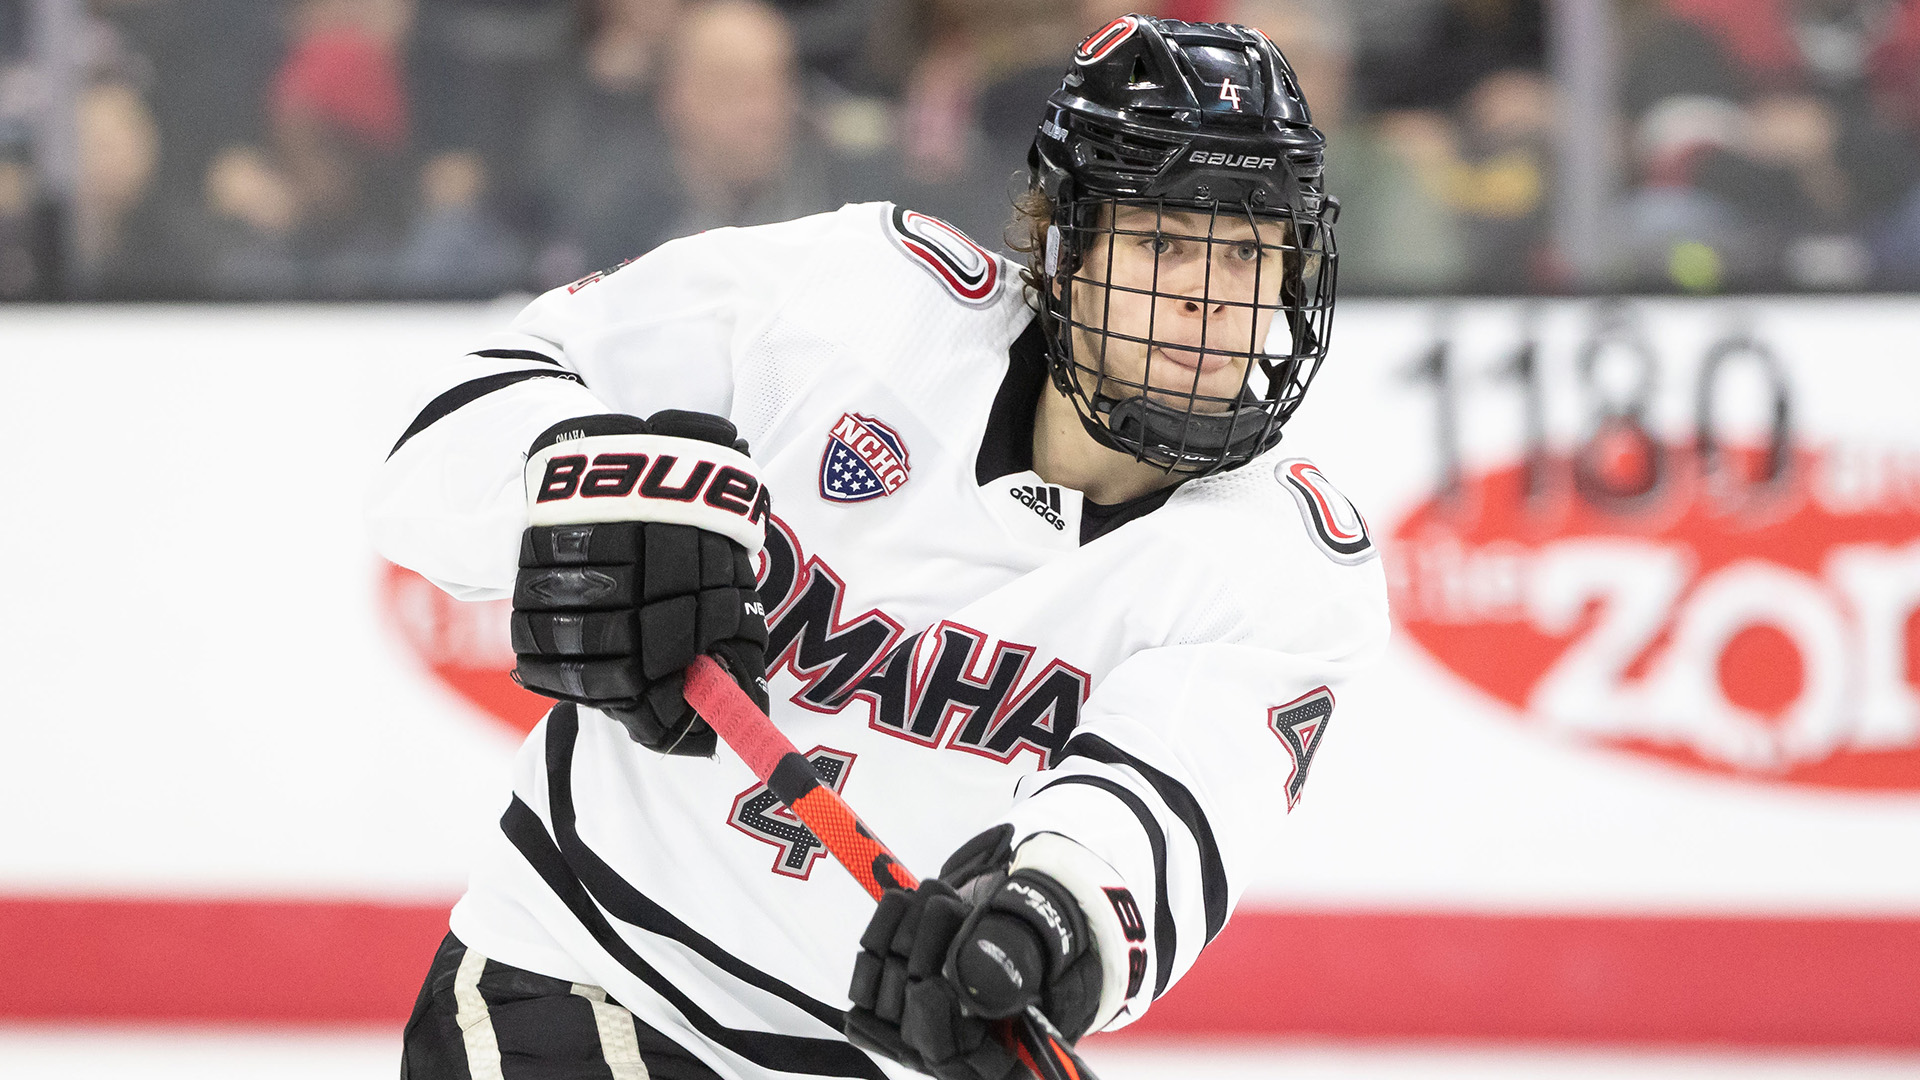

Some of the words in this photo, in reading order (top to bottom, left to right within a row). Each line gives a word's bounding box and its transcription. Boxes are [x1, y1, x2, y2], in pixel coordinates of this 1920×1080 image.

[1219, 78, 1241, 110] 4
[1189, 150, 1277, 171] BAUER
[833, 415, 908, 492] NCHC
[1392, 336, 1790, 515] 1180
[1009, 485, 1066, 532] adidas
[1267, 685, 1336, 814] 4
[726, 744, 858, 881] 4
